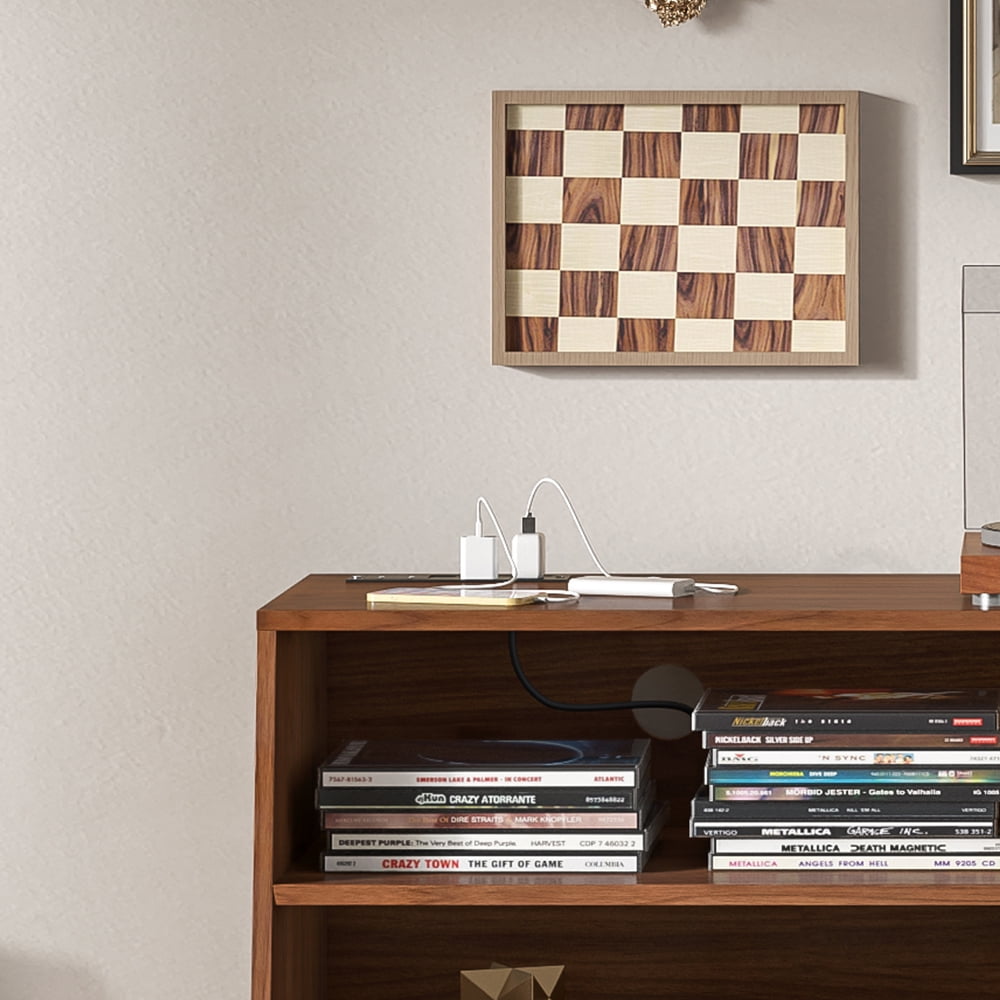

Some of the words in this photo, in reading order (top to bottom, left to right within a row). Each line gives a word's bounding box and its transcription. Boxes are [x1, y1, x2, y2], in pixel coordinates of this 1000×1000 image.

[765, 736, 788, 744] SILVER
[449, 795, 478, 805] CRAZY
[481, 795, 536, 805] ATORRANTE
[761, 828, 831, 836] METALLICA
[474, 840, 493, 848] Deep
[781, 844, 840, 853] METALLICA
[850, 844, 886, 853] DEATH
[890, 844, 946, 853] MAGNETIC
[381, 859, 421, 869] CRAZY
[425, 859, 459, 869] TOWN
[468, 860, 488, 868] THE
[491, 860, 514, 868] GIFT
[517, 860, 530, 868] OF
[534, 860, 564, 868] GAME
